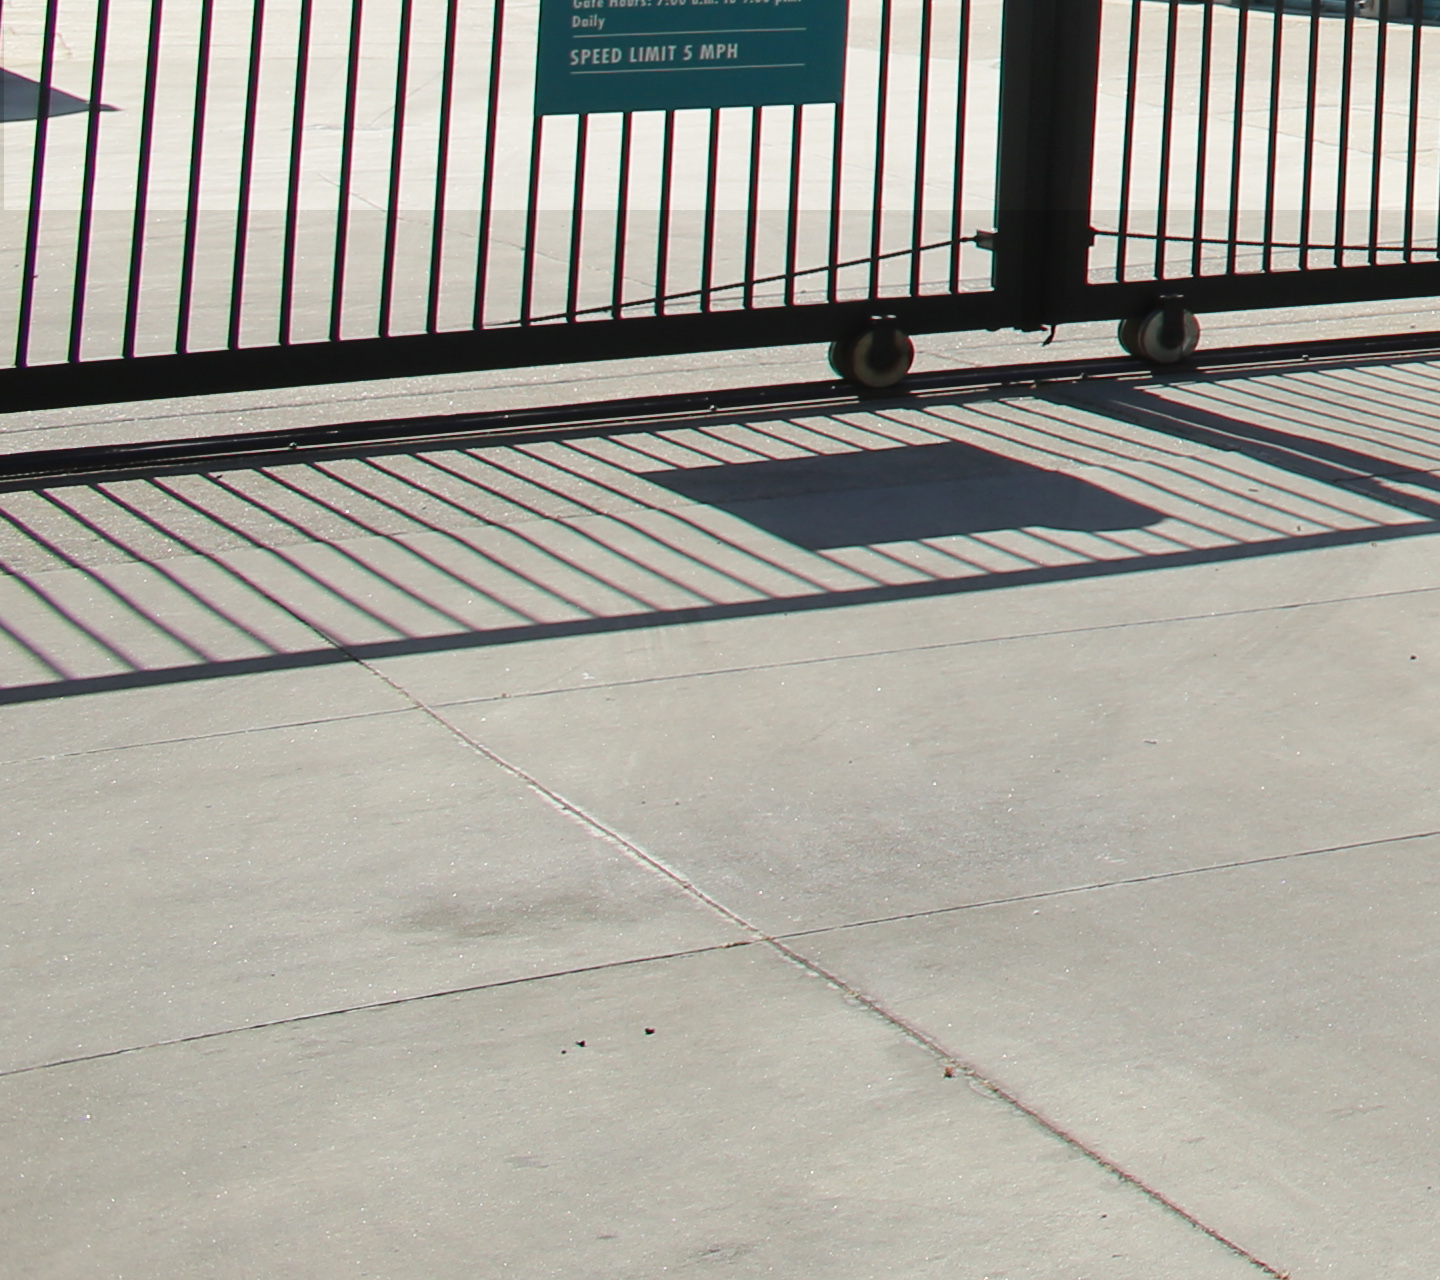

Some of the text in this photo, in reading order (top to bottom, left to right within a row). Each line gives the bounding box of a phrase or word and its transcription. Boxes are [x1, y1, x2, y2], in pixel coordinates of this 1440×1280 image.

[572, 14, 605, 30] Daily
[570, 43, 738, 66] SPEED LIMIT 5 MPH
